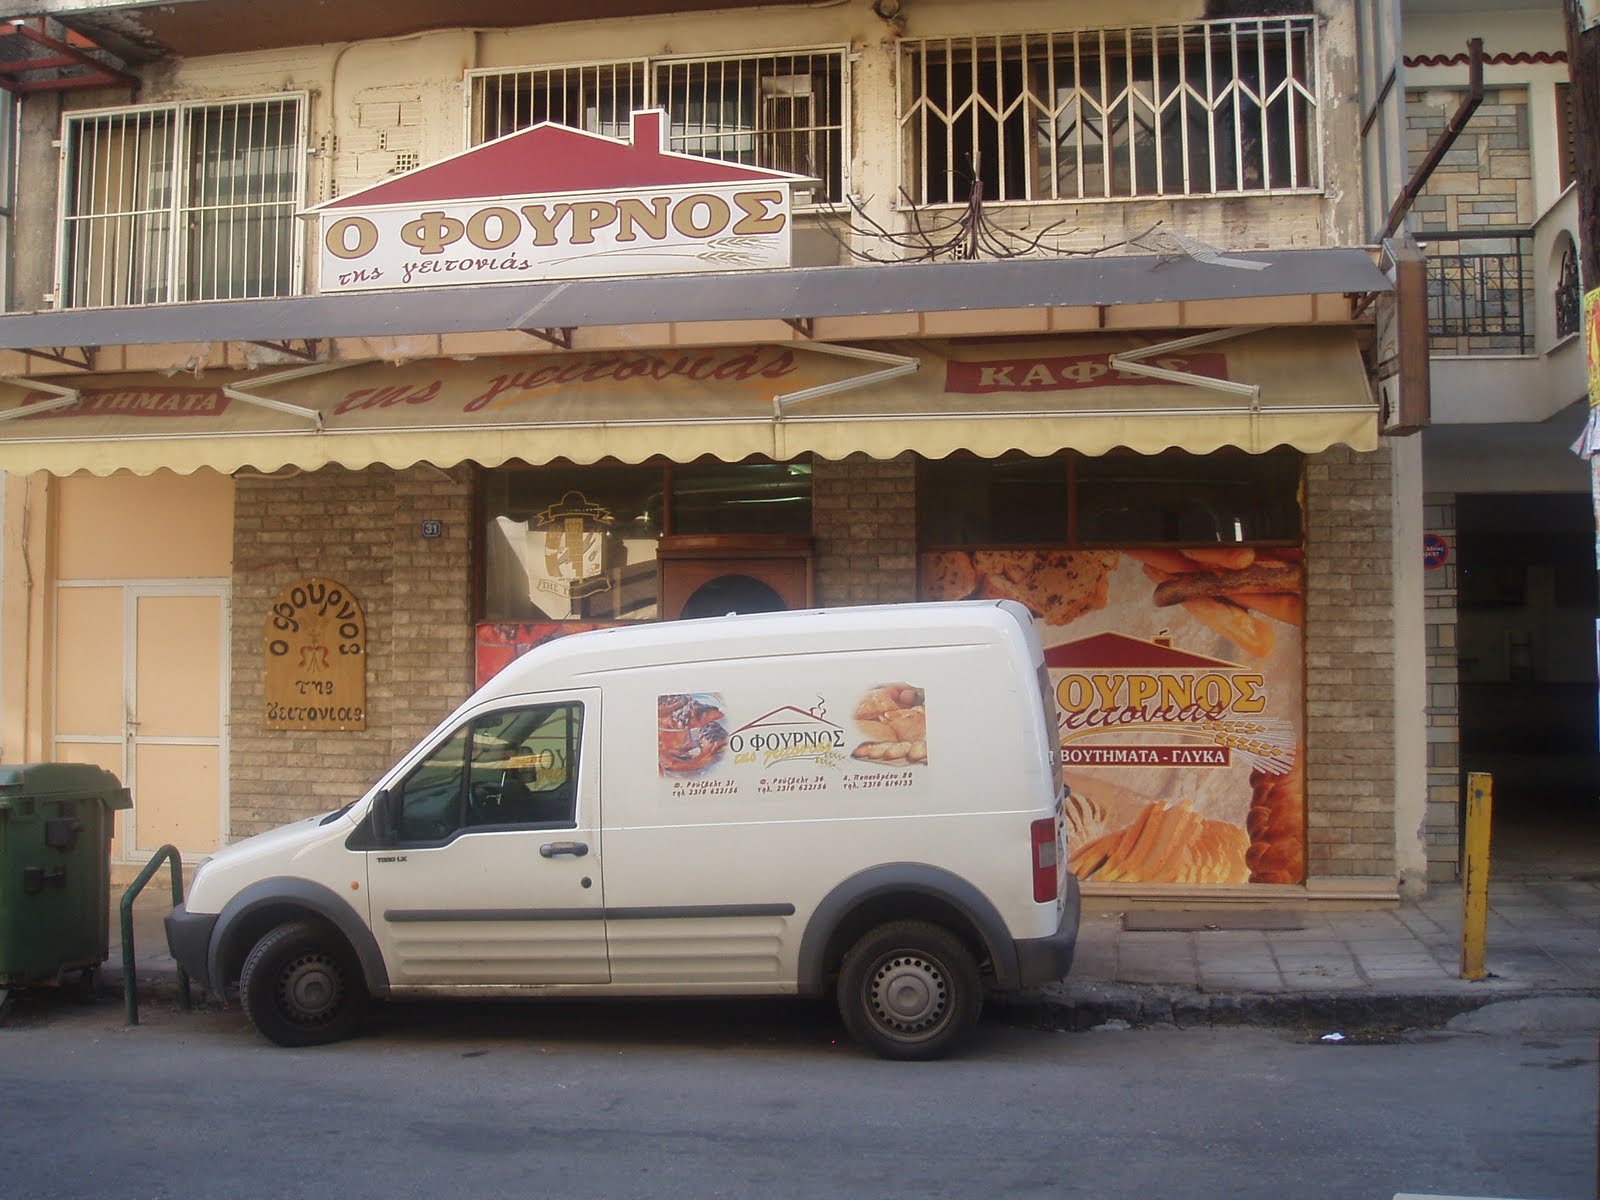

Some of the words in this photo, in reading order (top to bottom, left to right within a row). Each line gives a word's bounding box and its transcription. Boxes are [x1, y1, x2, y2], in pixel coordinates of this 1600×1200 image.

[325, 216, 379, 260] Ο
[400, 190, 787, 255] ΦΟΥΡΝΟΣ
[402, 252, 532, 284] γειτονιάς
[1057, 674, 1266, 713] ΟΥΡΝΟΣ
[730, 735, 744, 752] Ο
[750, 730, 845, 751] ΦΟΥΡΝΟΣ
[1061, 750, 1159, 763] ΒΟΥΤΗΜΑΤΑ
[1172, 750, 1226, 763] ΓΛΥΚΑ
[710, 787, 738, 795] 622156
[799, 783, 827, 791] 622156
